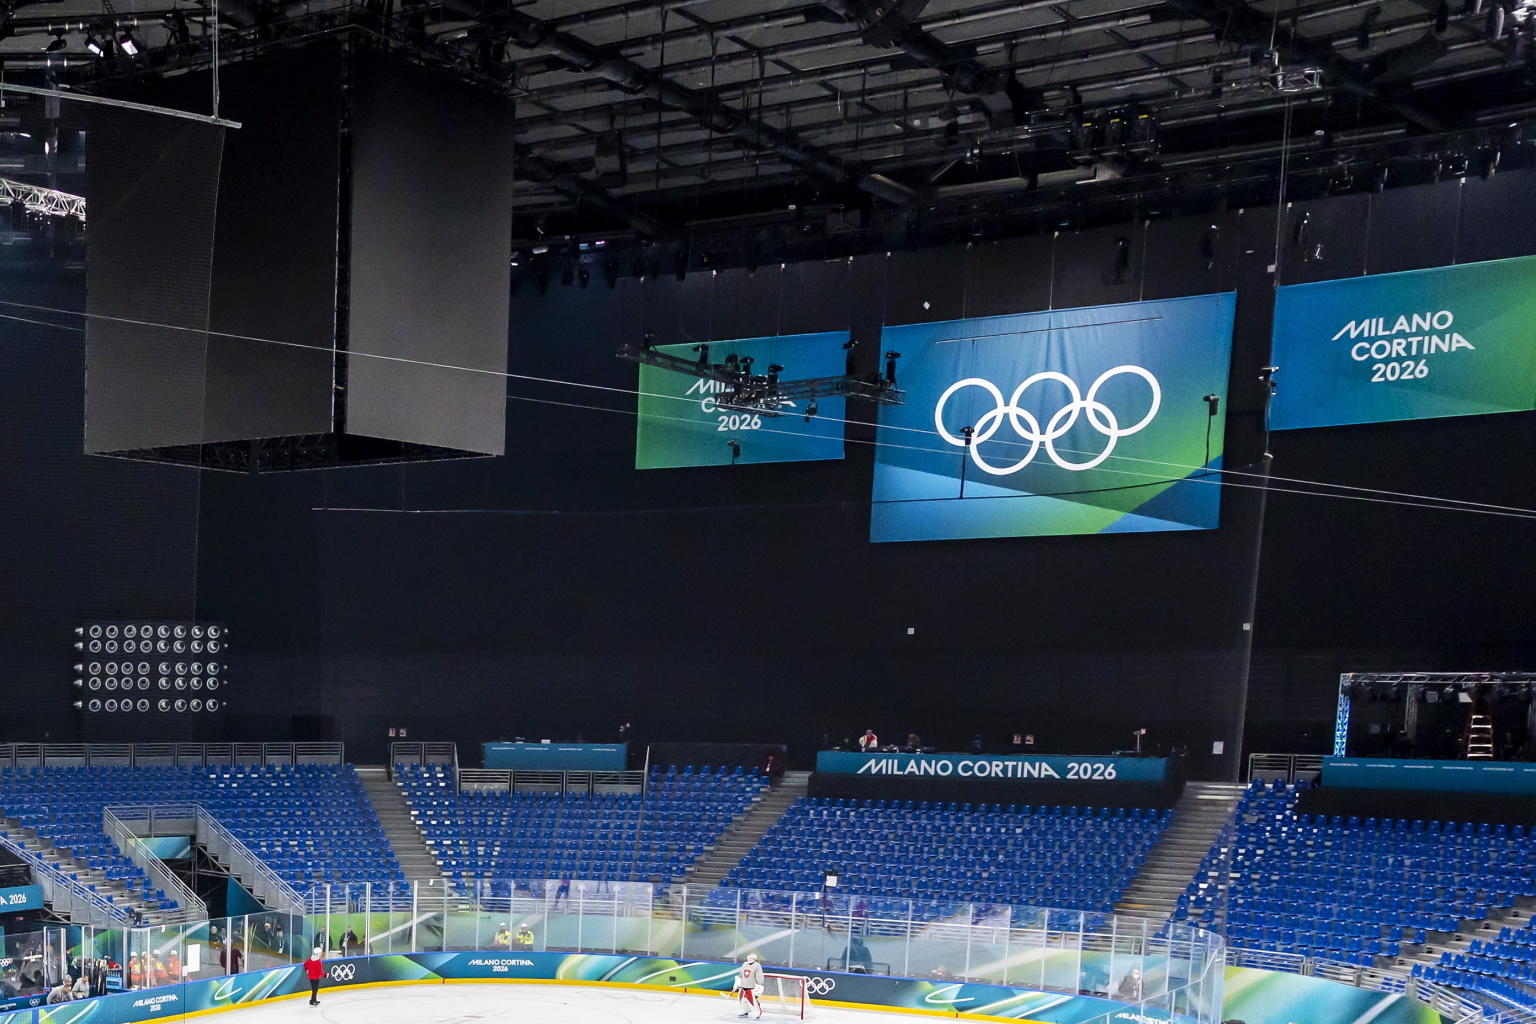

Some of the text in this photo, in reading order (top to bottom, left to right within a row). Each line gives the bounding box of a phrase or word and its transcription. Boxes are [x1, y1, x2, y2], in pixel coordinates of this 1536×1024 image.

[1331, 310, 1454, 341] MILANO
[1351, 332, 1476, 361] CORTINA
[1371, 359, 1429, 383] 2026
[717, 414, 762, 432] 2026
[857, 758, 1117, 780] MILANO CORTINA 2026
[9, 893, 26, 904] 2026
[133, 998, 155, 1008] MILANO
